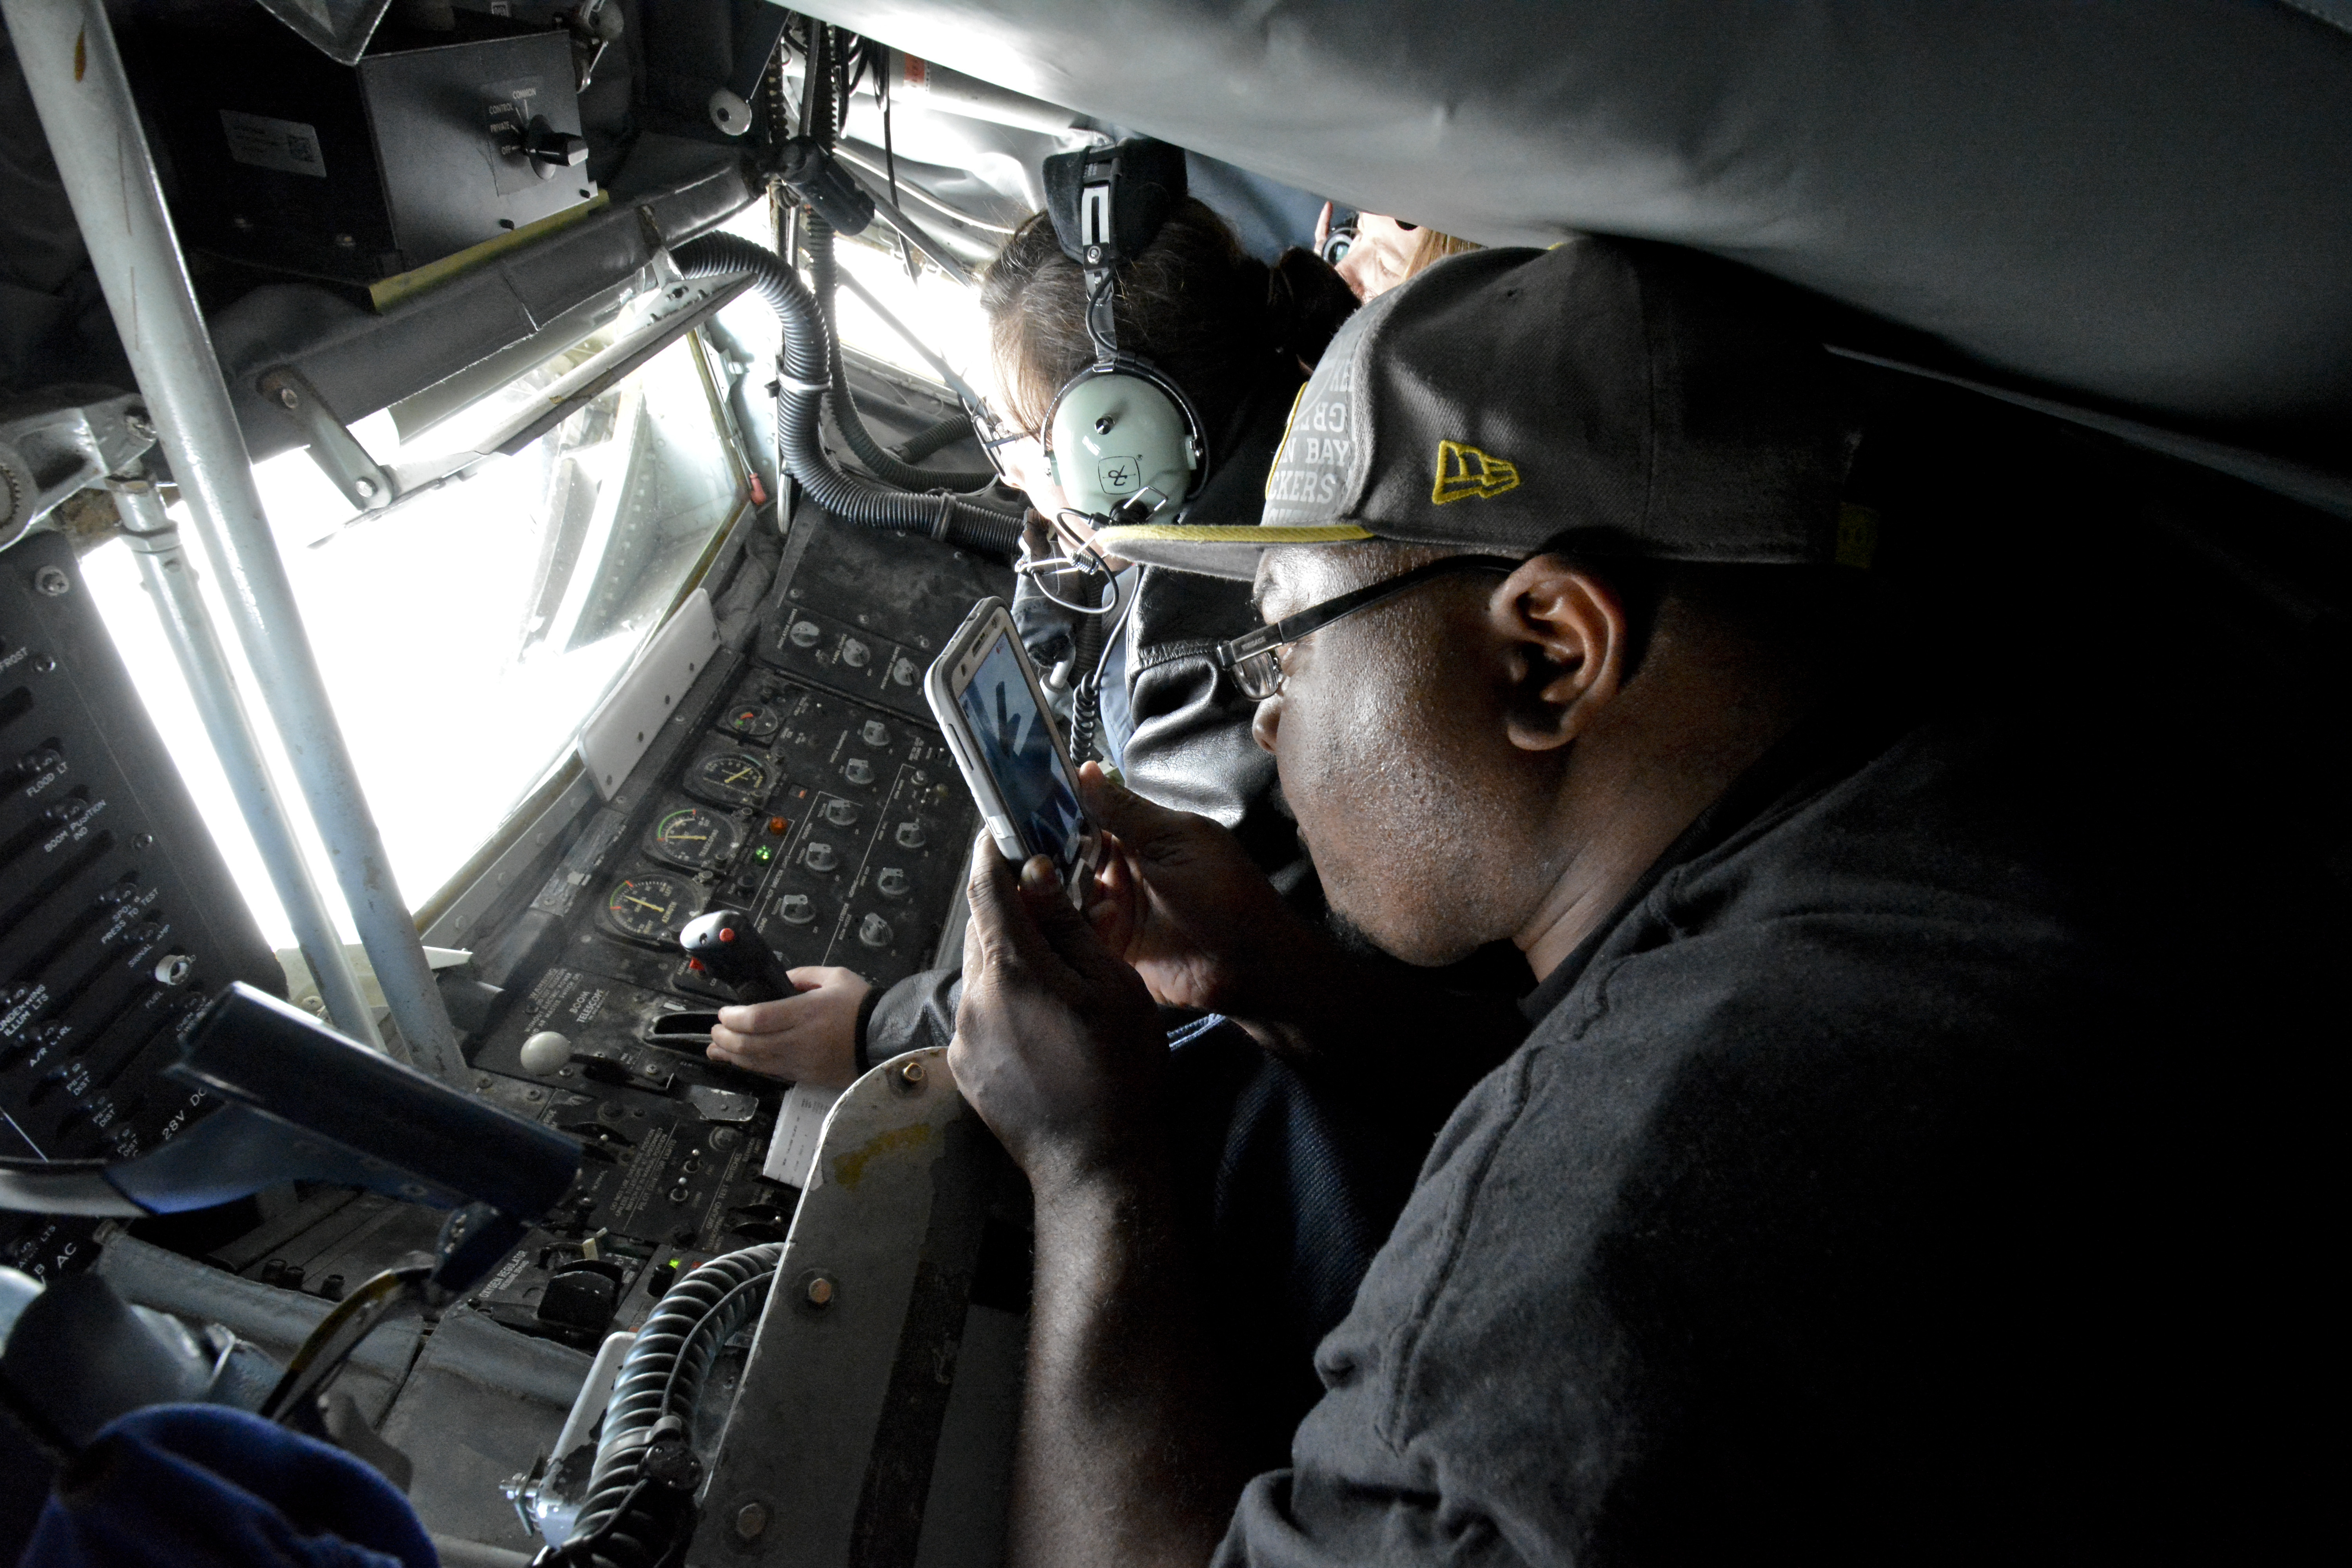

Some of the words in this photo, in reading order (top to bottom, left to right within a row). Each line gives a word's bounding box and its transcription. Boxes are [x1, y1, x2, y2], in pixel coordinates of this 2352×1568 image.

[512, 87, 537, 99] COMMON
[488, 102, 513, 114] CONTROL
[490, 121, 510, 132] PRIVATE
[501, 145, 512, 154] OFF
[1305, 438, 1350, 467] BAY
[26, 772, 55, 797] FLOOD
[56, 762, 69, 774] LT
[44, 830, 68, 852] BOOM
[73, 826, 88, 840] IND
[101, 920, 126, 943] PRESS
[129, 907, 139, 917] TO
[142, 888, 159, 906] TEST
[128, 943, 152, 967] SIGNAL
[155, 924, 171, 940] AMP
[528, 968, 558, 999] WARNING
[558, 973, 572, 987] POWER
[145, 991, 163, 1008] FUEL
[568, 991, 590, 1013] BOOM
[576, 989, 604, 1022] TELESCOPE
[4, 1011, 30, 1037] ILLUM
[32, 993, 49, 1009] LTS
[28, 1047, 47, 1066] A/R
[73, 1076, 91, 1095] DIST
[99, 1109, 116, 1126] DIST
[162, 1110, 185, 1140] 28V
[637, 1193, 651, 1210] PILOT
[646, 1161, 666, 1190] DIRECTOR
[662, 1139, 677, 1159] LIGHTS
[717, 1184, 729, 1199] TEST
[725, 1152, 743, 1182] SWITCHES
[40, 1225, 56, 1242] LTS
[56, 1243, 76, 1269] AC
[479, 1278, 503, 1297] OXYGEN
[497, 1250, 528, 1276] REGULATOR
